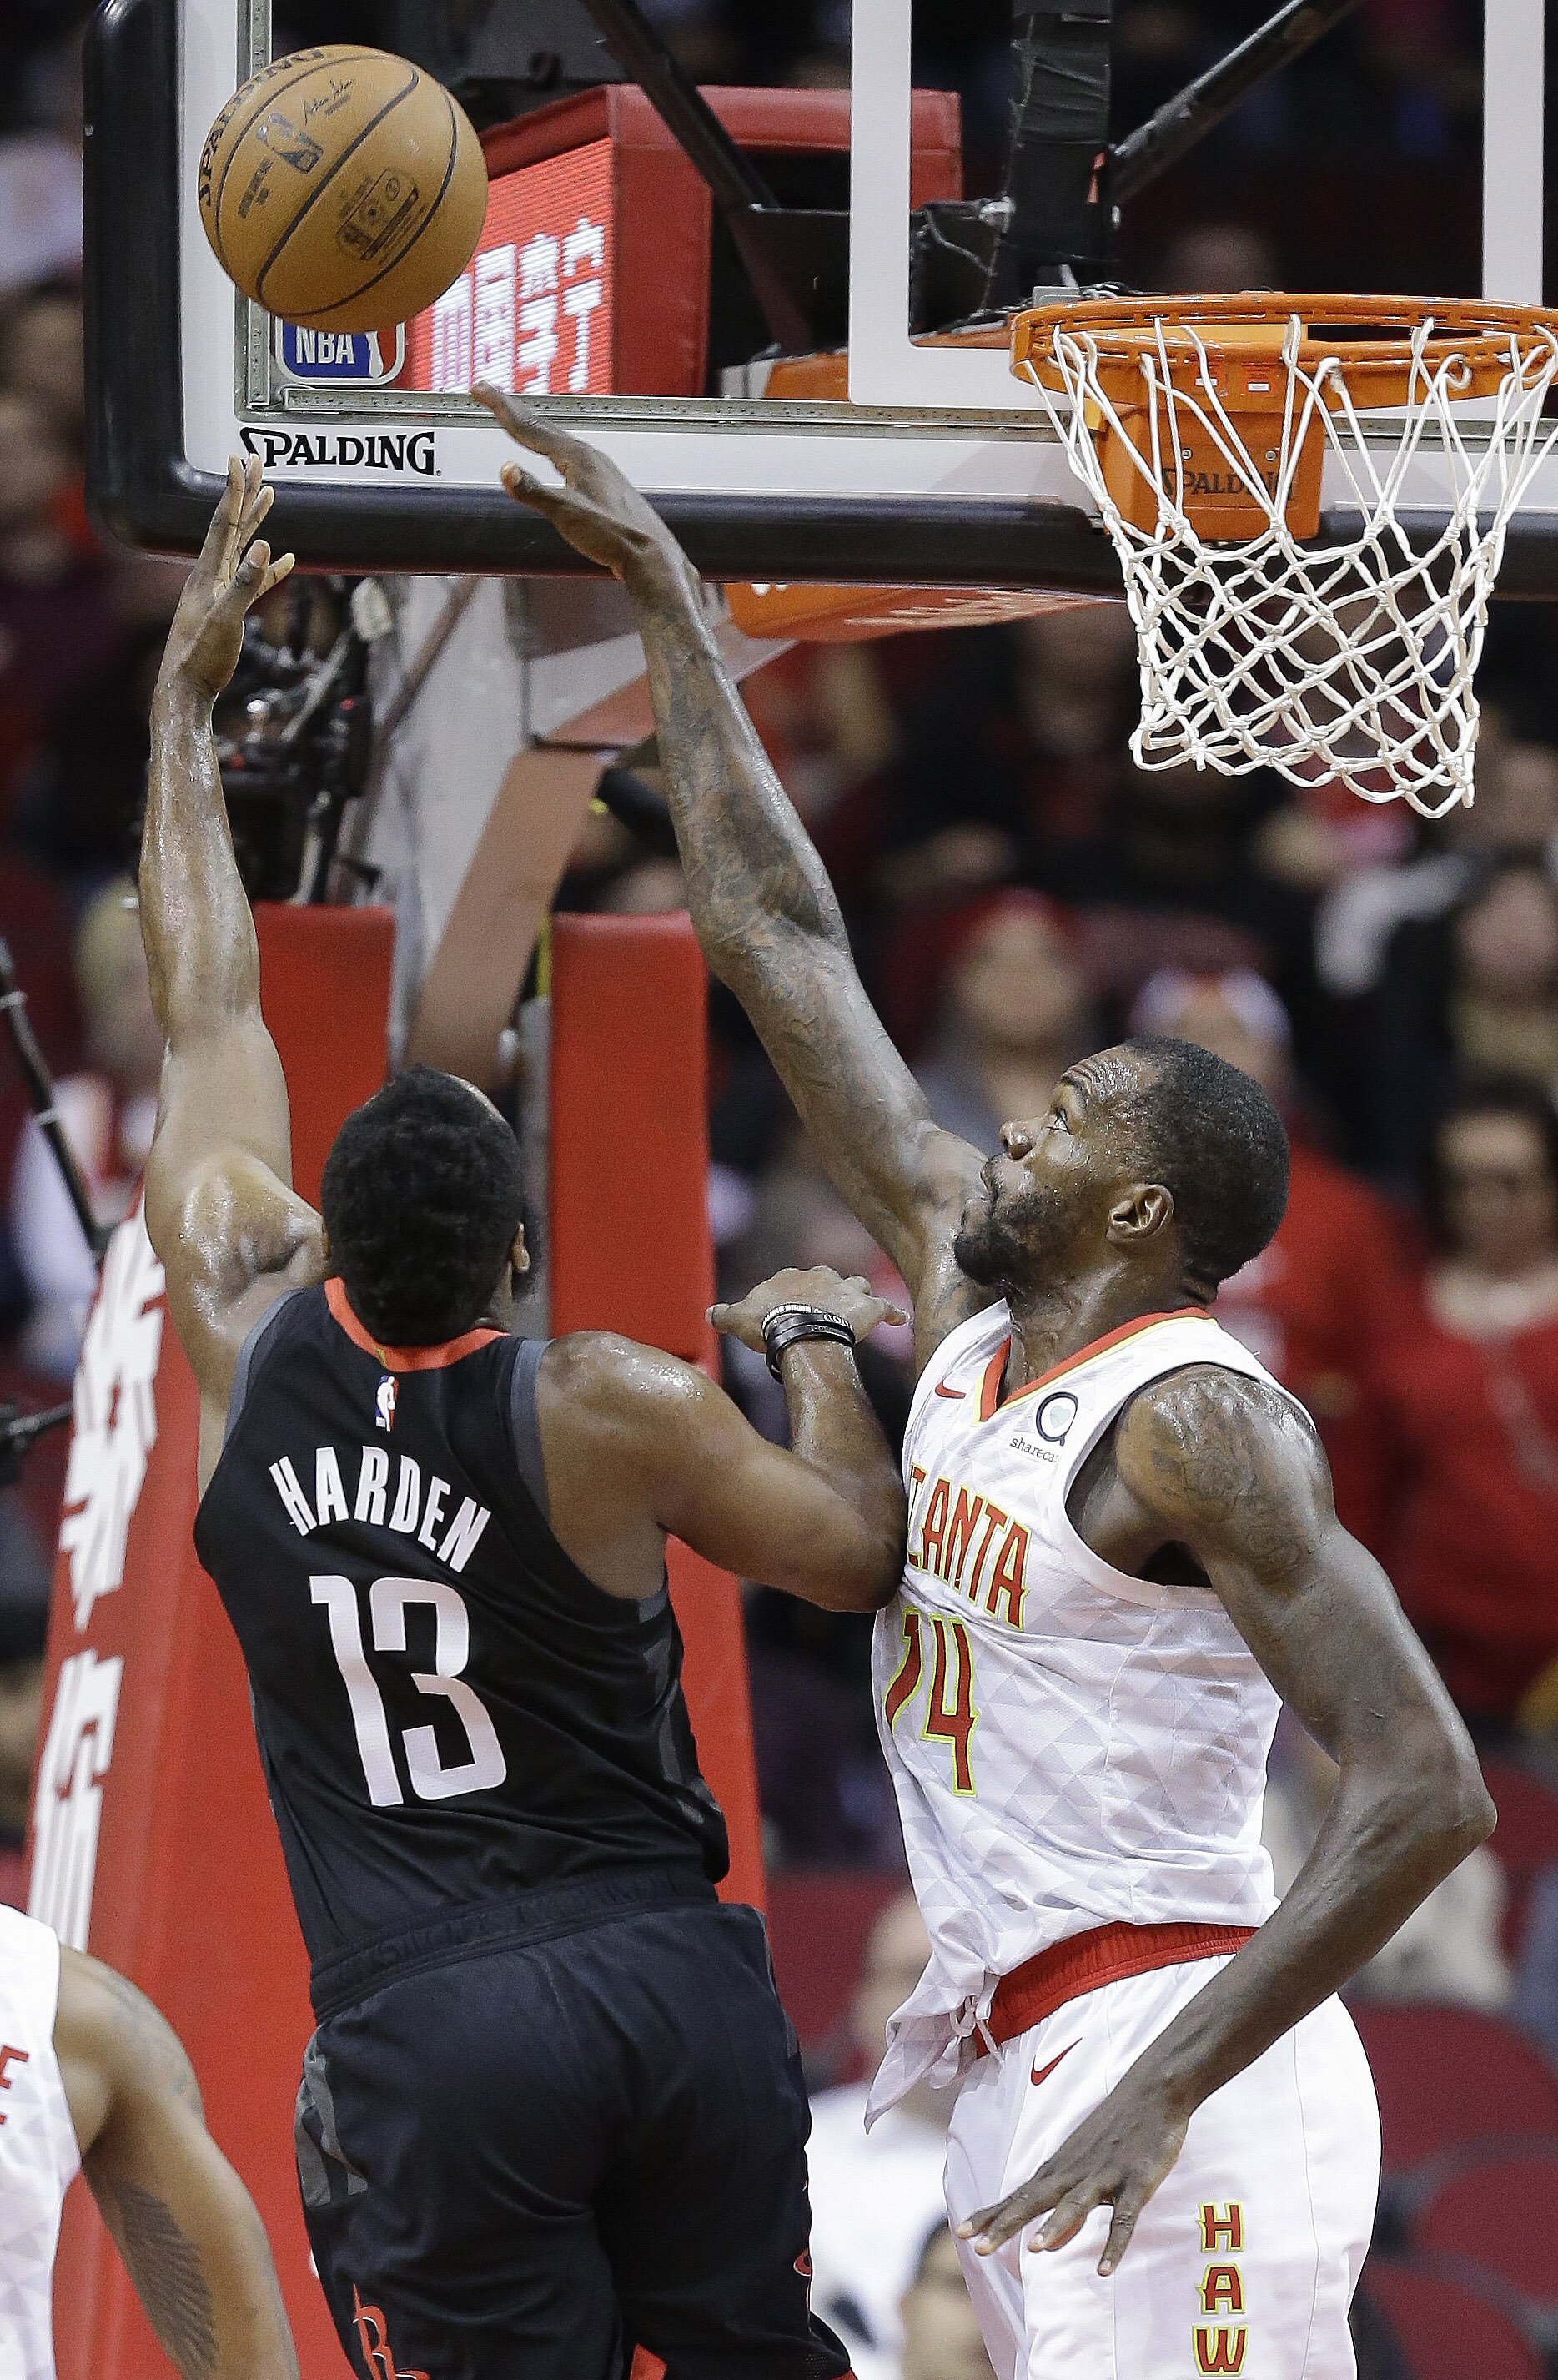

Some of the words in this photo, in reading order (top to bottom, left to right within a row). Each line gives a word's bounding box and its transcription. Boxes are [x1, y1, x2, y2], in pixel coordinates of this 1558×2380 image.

[295, 325, 355, 365] NBA
[239, 426, 435, 476] SPALDING
[269, 1445, 491, 1574] HARDEN
[309, 1574, 507, 1807] 13
[1192, 2201, 1249, 2377] HAW
